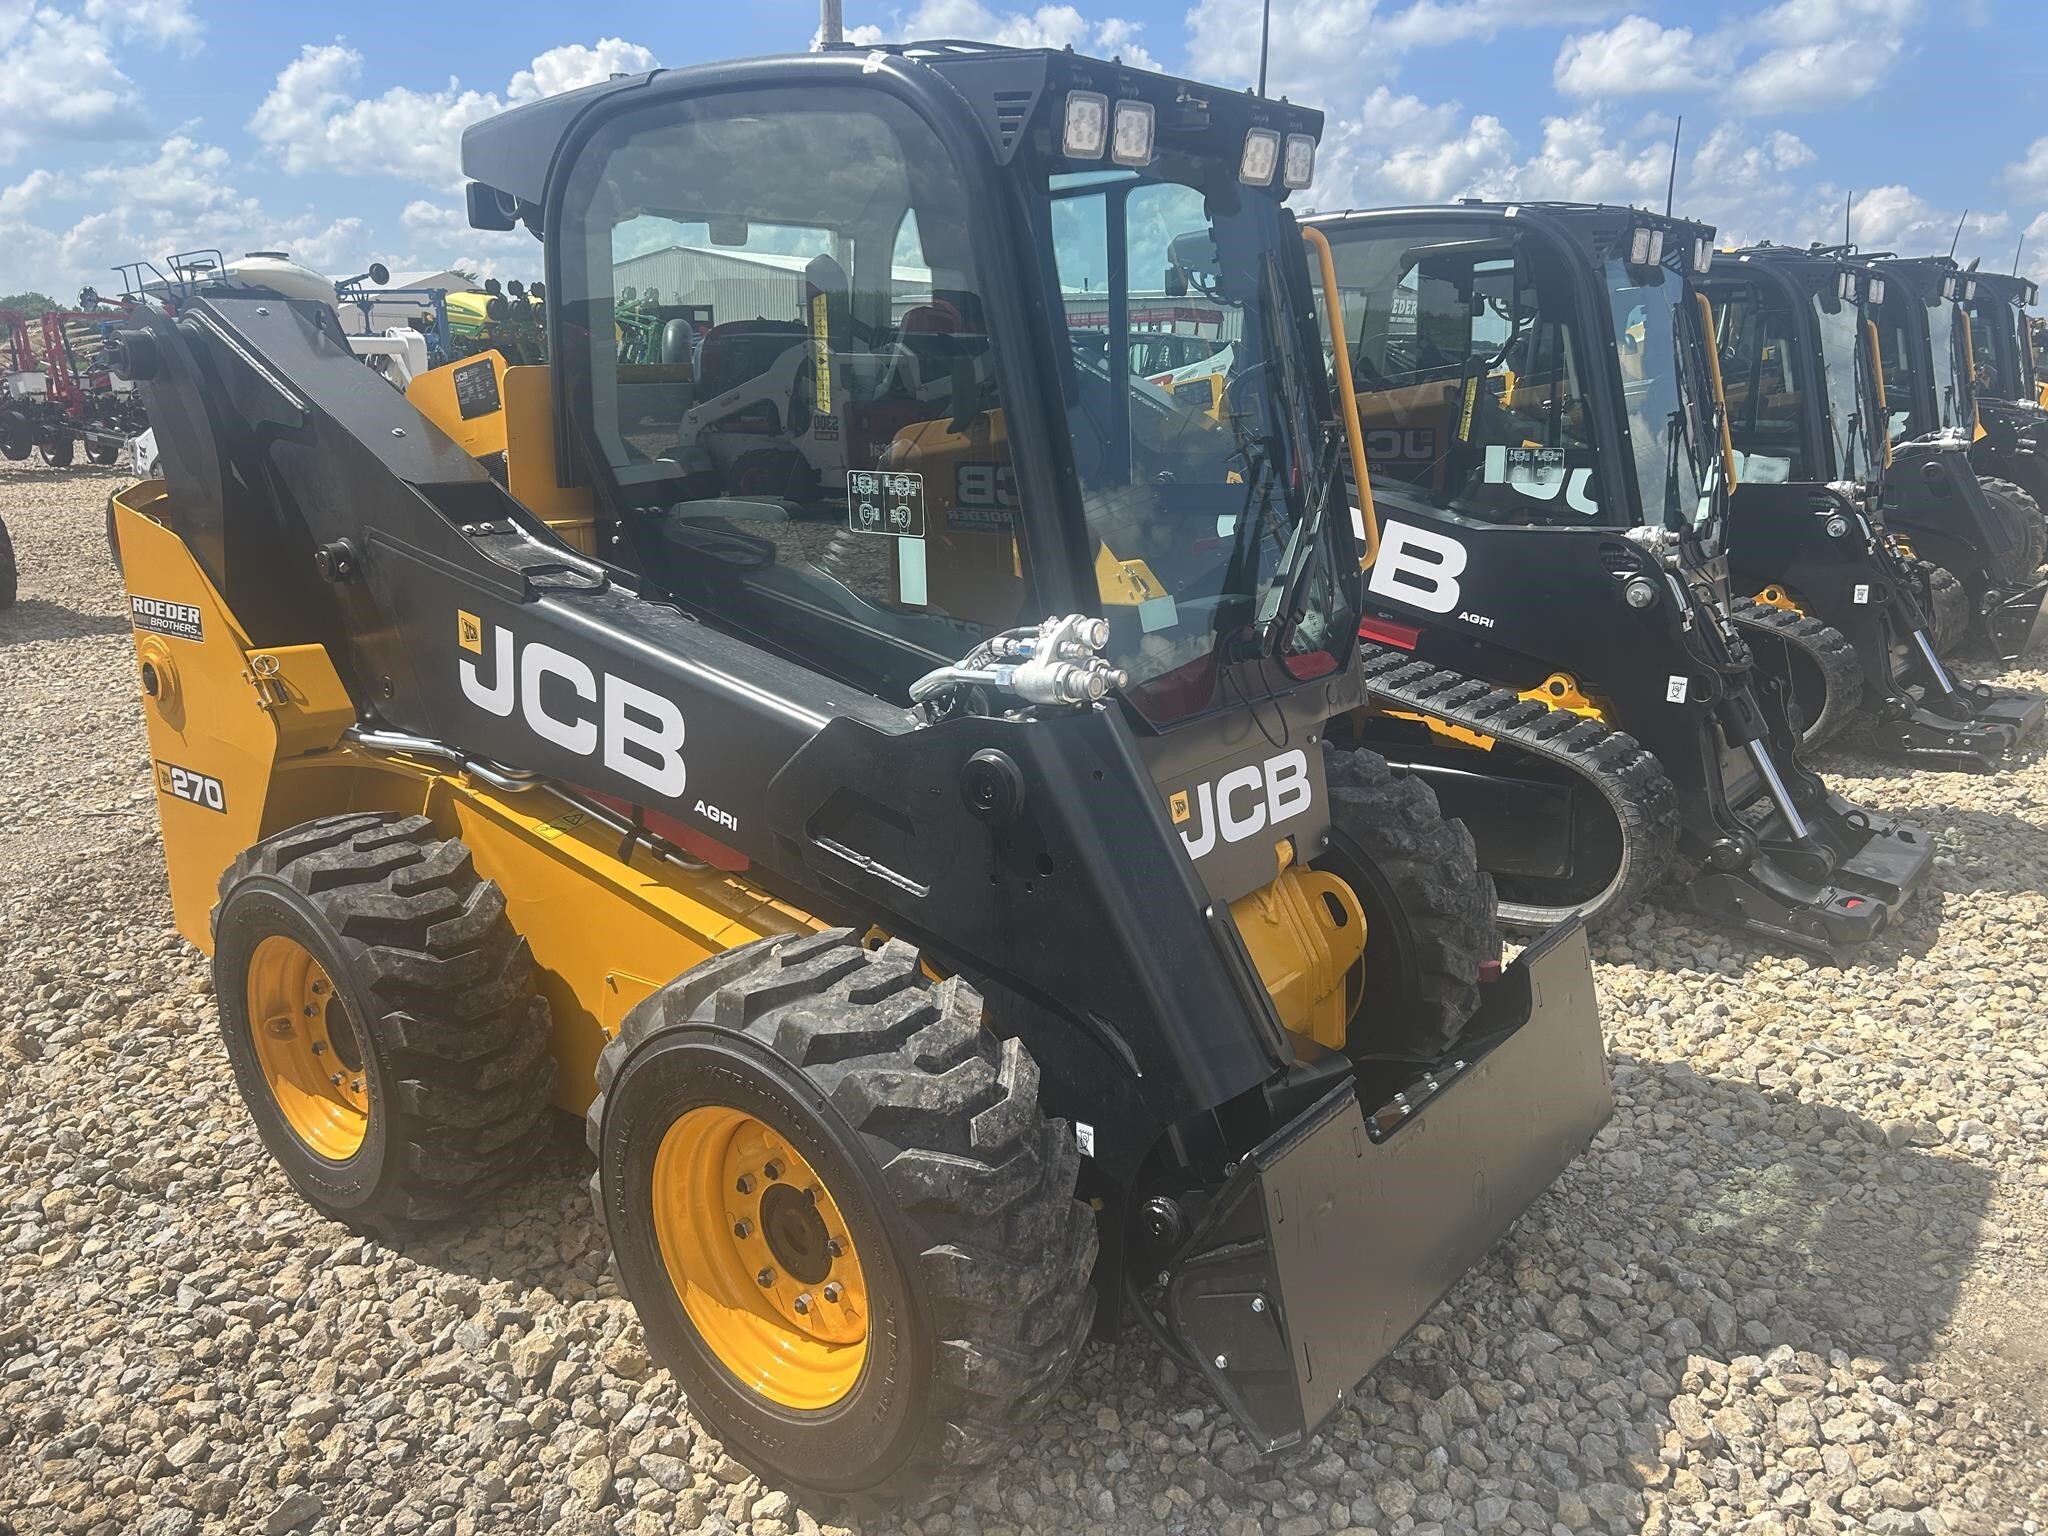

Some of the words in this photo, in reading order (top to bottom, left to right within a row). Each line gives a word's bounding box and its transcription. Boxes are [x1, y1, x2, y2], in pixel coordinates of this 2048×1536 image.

[455, 371, 468, 382] JCB
[132, 597, 200, 624] ROEDER
[1458, 611, 1495, 628] AGRI
[150, 617, 198, 635] BROTHERS
[458, 624, 687, 798] JCB
[171, 767, 223, 810] 270
[693, 800, 738, 831] AGRI
[1179, 749, 1312, 861] JCB
